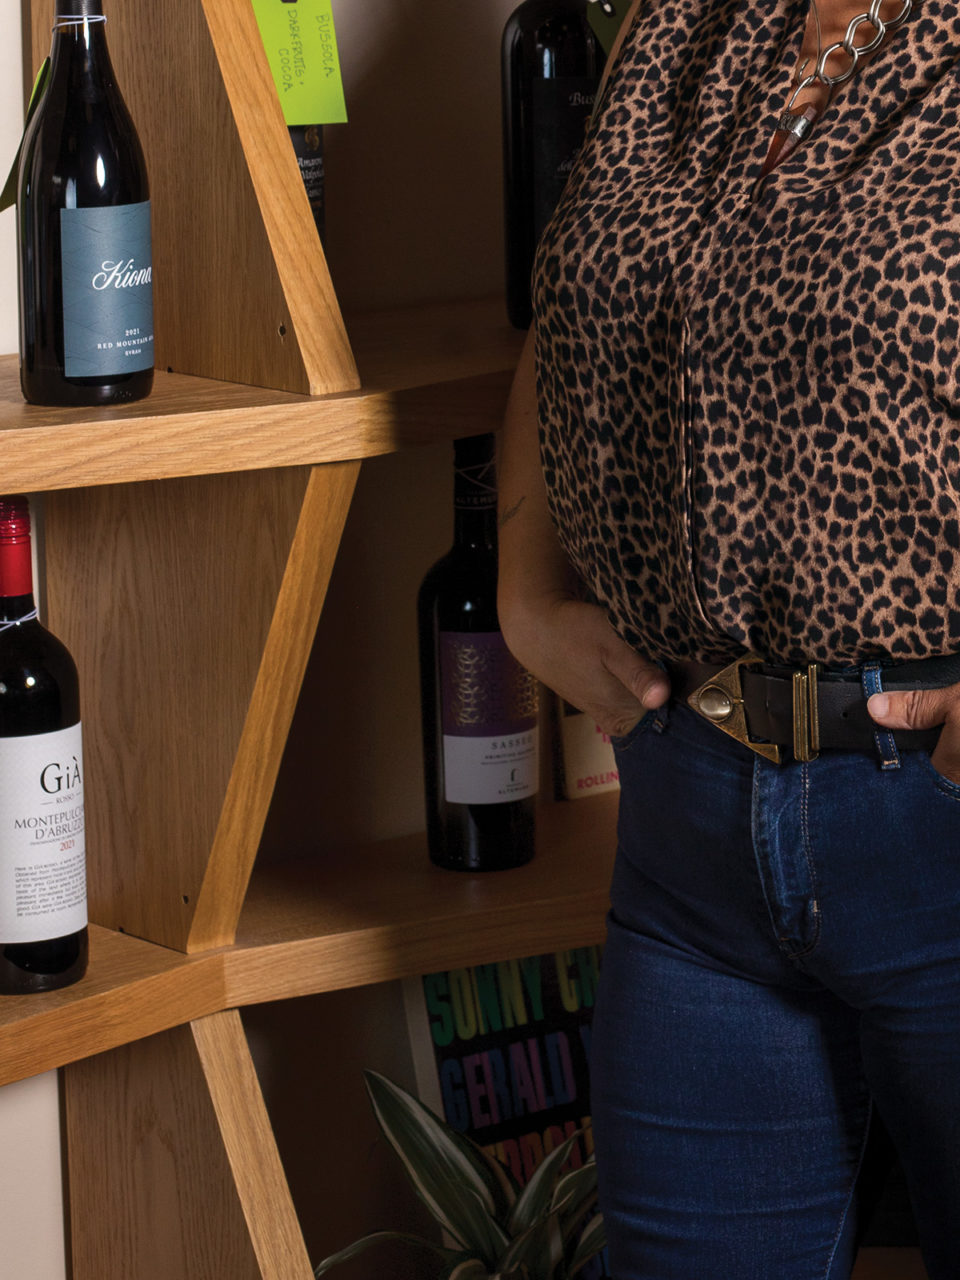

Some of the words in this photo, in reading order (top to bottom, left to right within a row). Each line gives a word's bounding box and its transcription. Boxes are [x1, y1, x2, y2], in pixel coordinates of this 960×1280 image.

[92, 258, 152, 291] Kiona
[97, 342, 114, 350] RED
[116, 337, 148, 348] MOUNTAIN
[125, 328, 141, 337] 2021
[40, 755, 82, 795] GiÀ
[60, 839, 75, 851] 2021
[422, 952, 545, 1047] SONNY
[441, 1031, 577, 1135] GERALD
